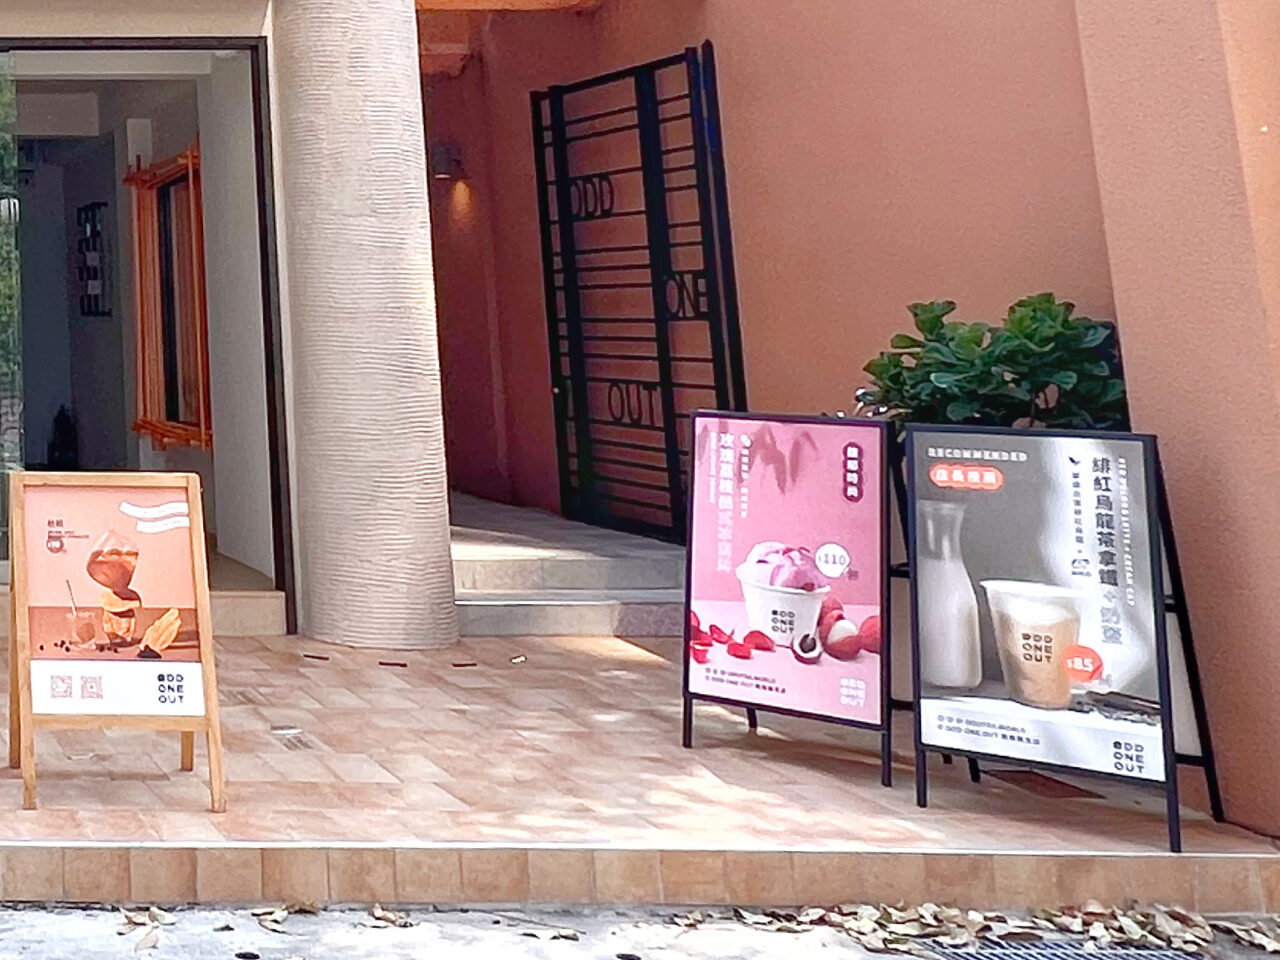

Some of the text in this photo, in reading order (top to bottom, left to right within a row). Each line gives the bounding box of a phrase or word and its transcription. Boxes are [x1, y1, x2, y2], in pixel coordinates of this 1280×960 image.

[607, 383, 661, 425] OUT
[927, 447, 1028, 462] RECOMMENDED
[1022, 642, 1052, 654] ONE
[1023, 653, 1052, 663] OUT
[158, 684, 184, 693] ONE
[158, 694, 184, 704] OUT
[1113, 751, 1145, 764] ONE
[1114, 761, 1145, 774] OUT
